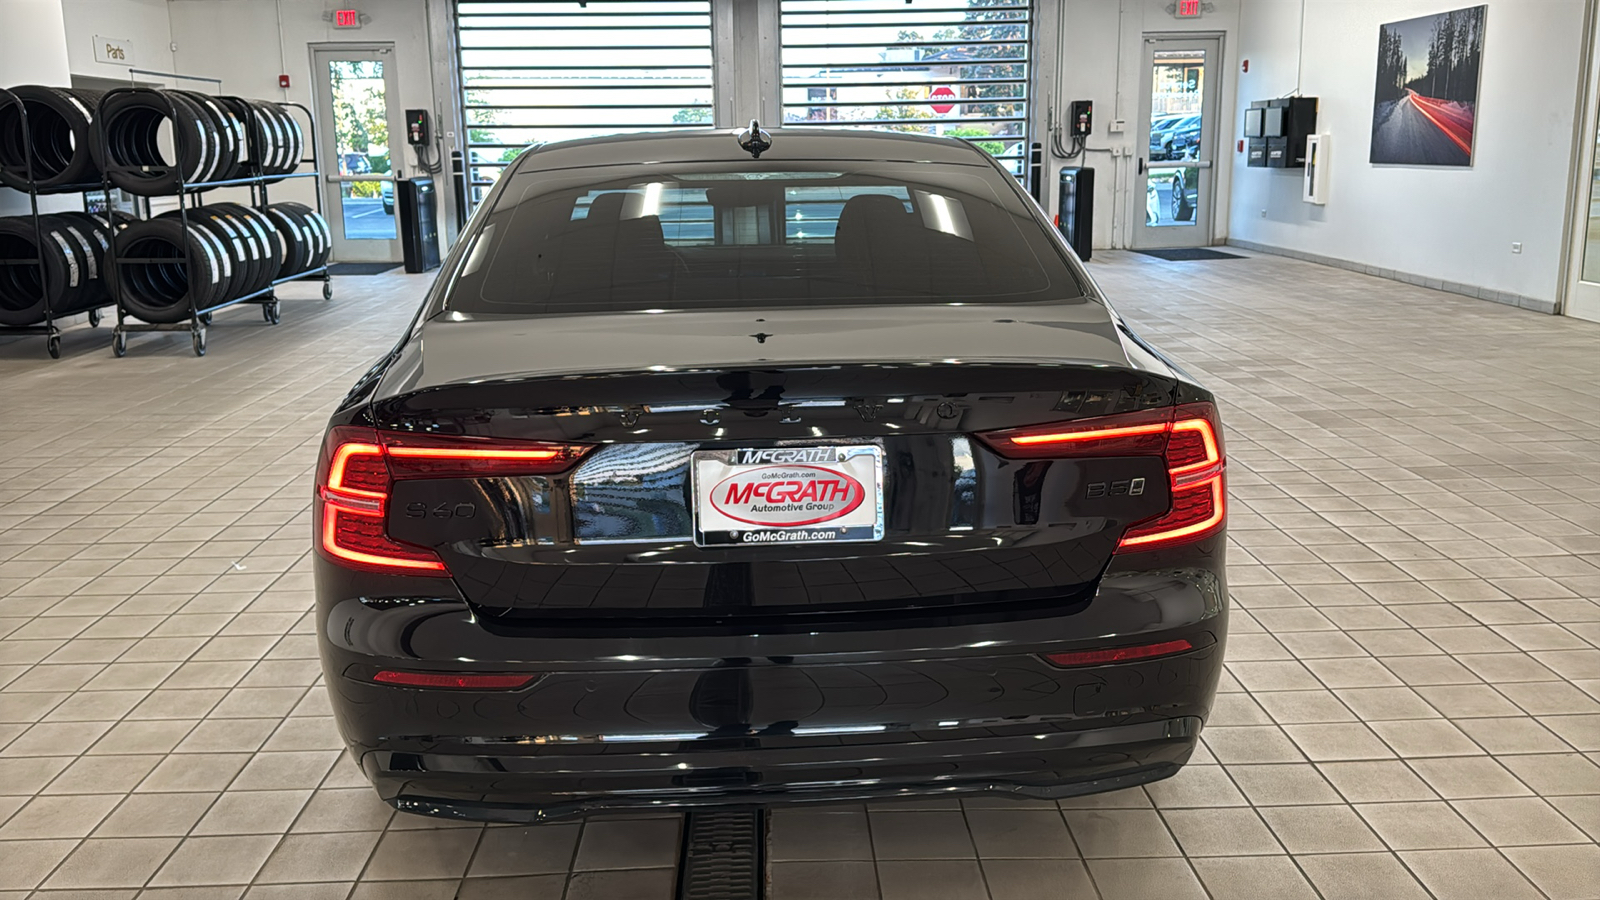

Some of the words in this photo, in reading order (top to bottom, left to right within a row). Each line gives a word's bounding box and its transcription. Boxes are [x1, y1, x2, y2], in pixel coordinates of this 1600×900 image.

[1179, 0, 1199, 15] EXIT
[336, 10, 356, 26] EXIT
[106, 43, 125, 60] Parts
[761, 472, 816, 480] GoMcGrath.com
[406, 502, 477, 519] S60
[750, 503, 804, 513] Automotive
[806, 502, 835, 513] Group
[742, 530, 836, 542] GoMcGrath.com
